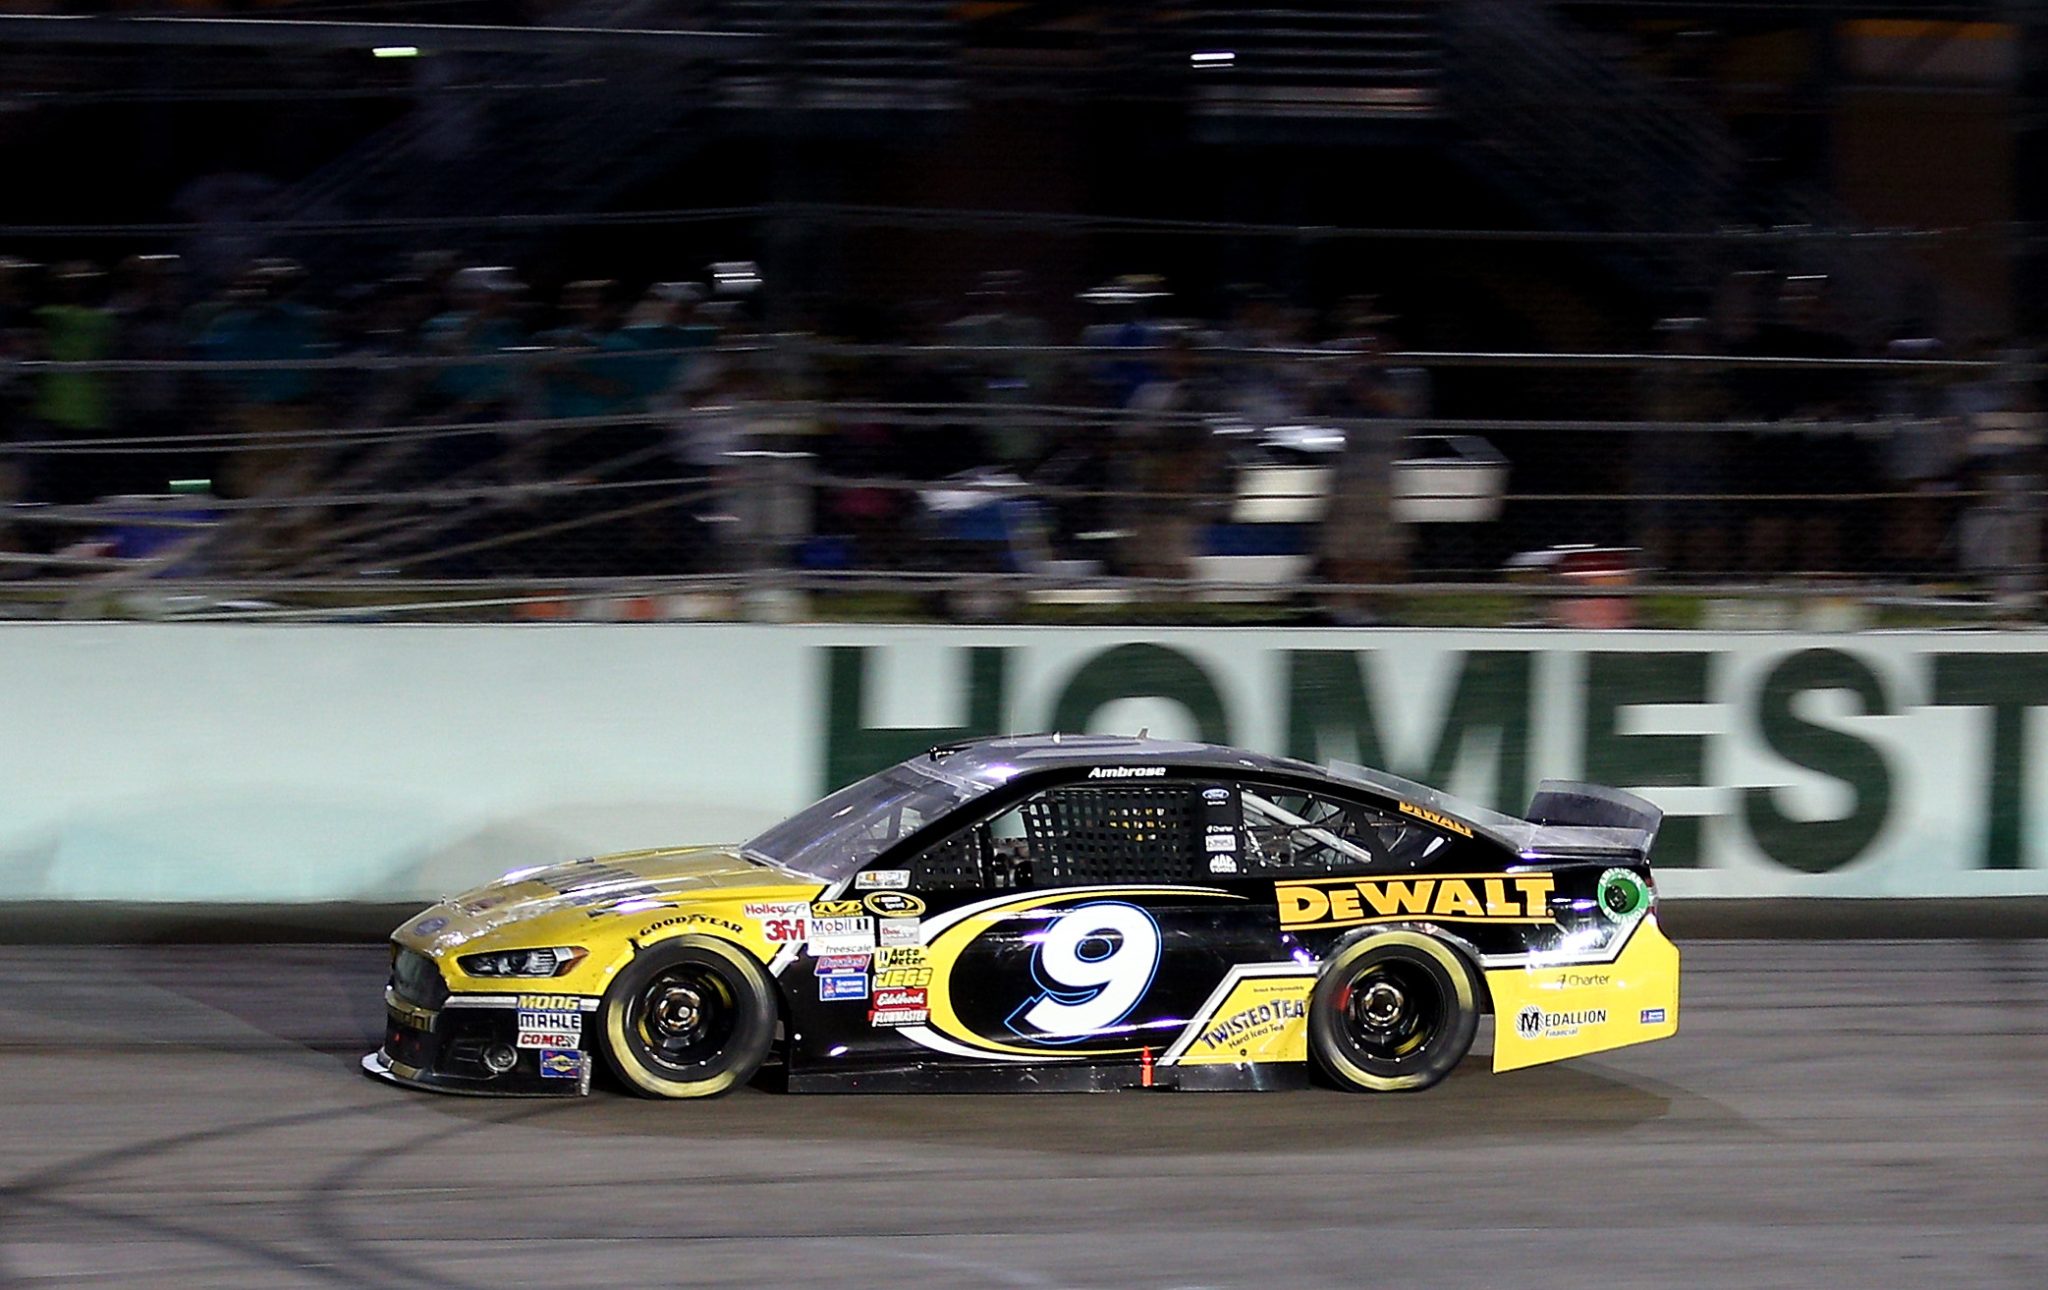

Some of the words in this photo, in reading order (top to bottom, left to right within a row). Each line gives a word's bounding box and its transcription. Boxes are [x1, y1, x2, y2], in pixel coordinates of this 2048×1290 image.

[1088, 766, 1167, 779] Ambrose
[745, 902, 785, 917] Holley
[640, 914, 744, 937] GOODYEAR
[765, 919, 806, 941] 3M
[811, 919, 852, 932] Mobil
[826, 944, 871, 954] freescale
[889, 948, 920, 957] Auto
[887, 957, 927, 967] Meter
[875, 967, 934, 988] JEGS
[1004, 900, 1162, 1045] 9
[1568, 974, 1610, 987] Charter
[518, 994, 581, 1011] MOOG
[520, 1013, 580, 1029] MAHLE
[1201, 1003, 1271, 1050] TWISTED
[1270, 998, 1306, 1018] TEA
[1228, 1034, 1250, 1049] Hard
[1251, 1025, 1269, 1041] Iced
[1270, 1022, 1285, 1034] Tea
